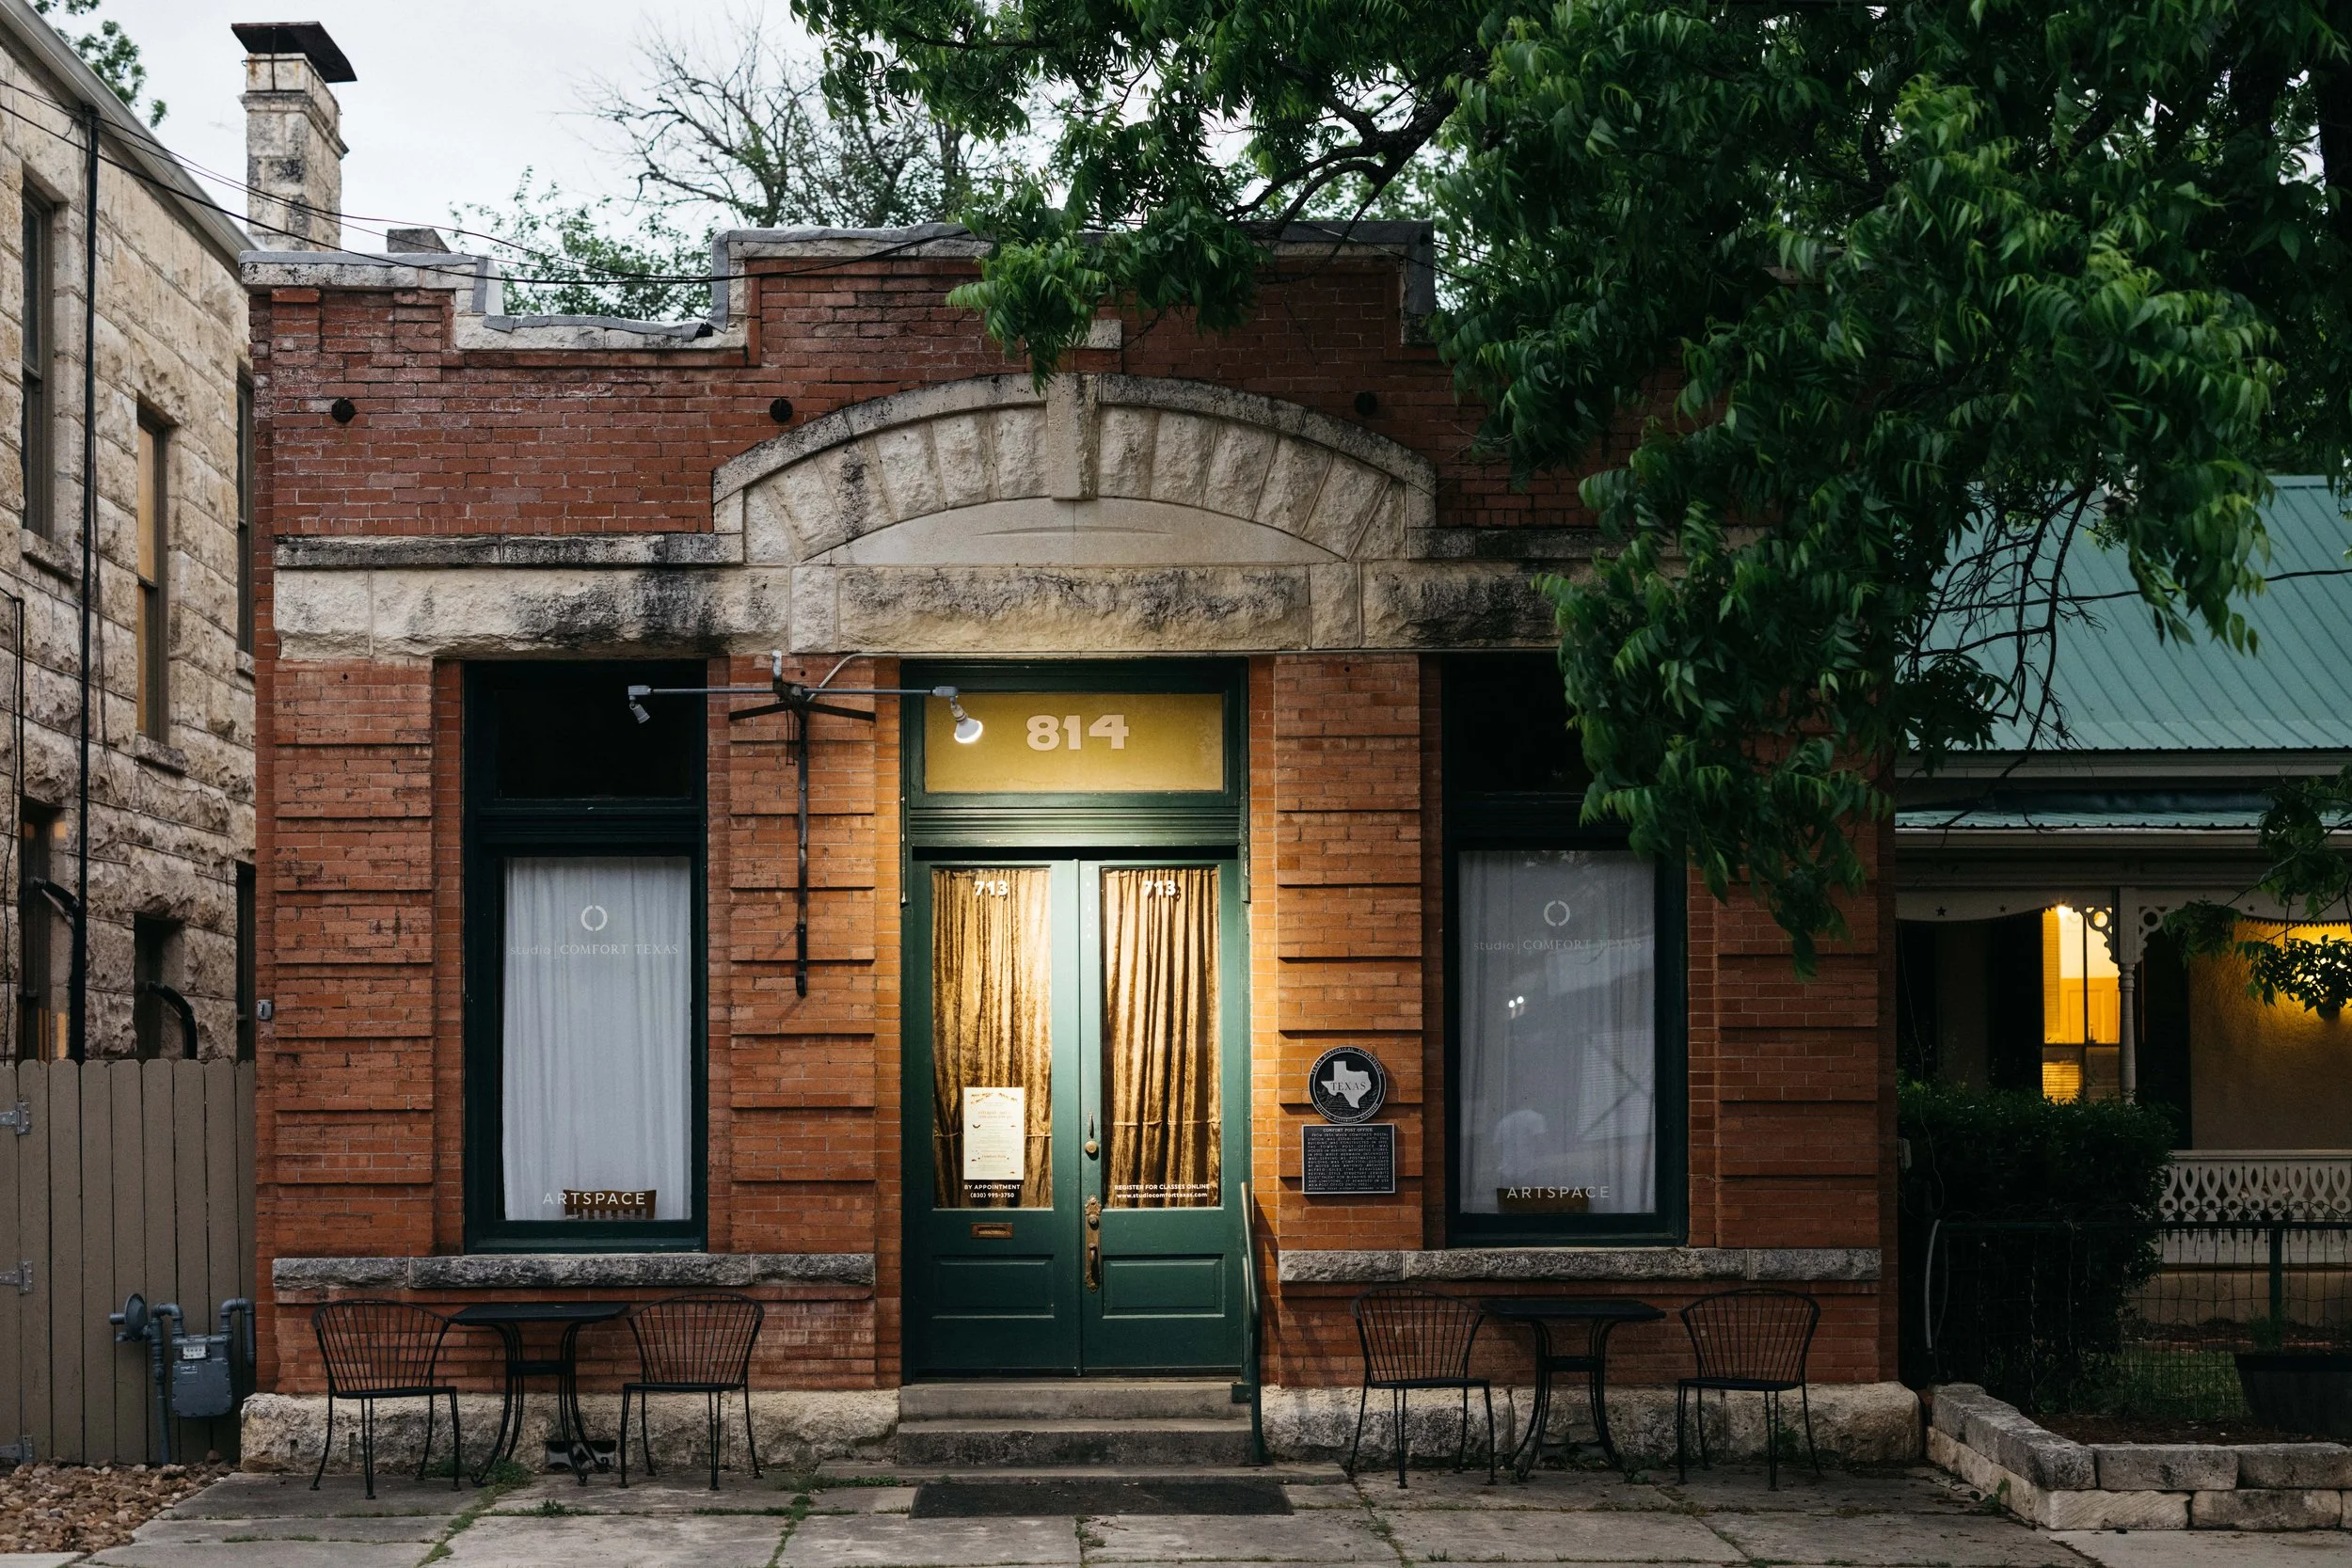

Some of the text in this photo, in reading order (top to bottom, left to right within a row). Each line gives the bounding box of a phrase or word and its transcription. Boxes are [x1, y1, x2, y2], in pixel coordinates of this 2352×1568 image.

[1025, 714, 1129, 752] 814
[974, 879, 1008, 896] 713
[1142, 879, 1176, 896] 713
[510, 943, 678, 956] studio COMFORT TEXAS
[1473, 939, 1642, 951] studio COMFORT TEXAS
[1311, 1060, 1323, 1075] TEXAS
[1330, 1082, 1366, 1091] TEXAS
[542, 1192, 645, 1205] ARTSPACE
[1506, 1186, 1610, 1198] ARTSPACE
